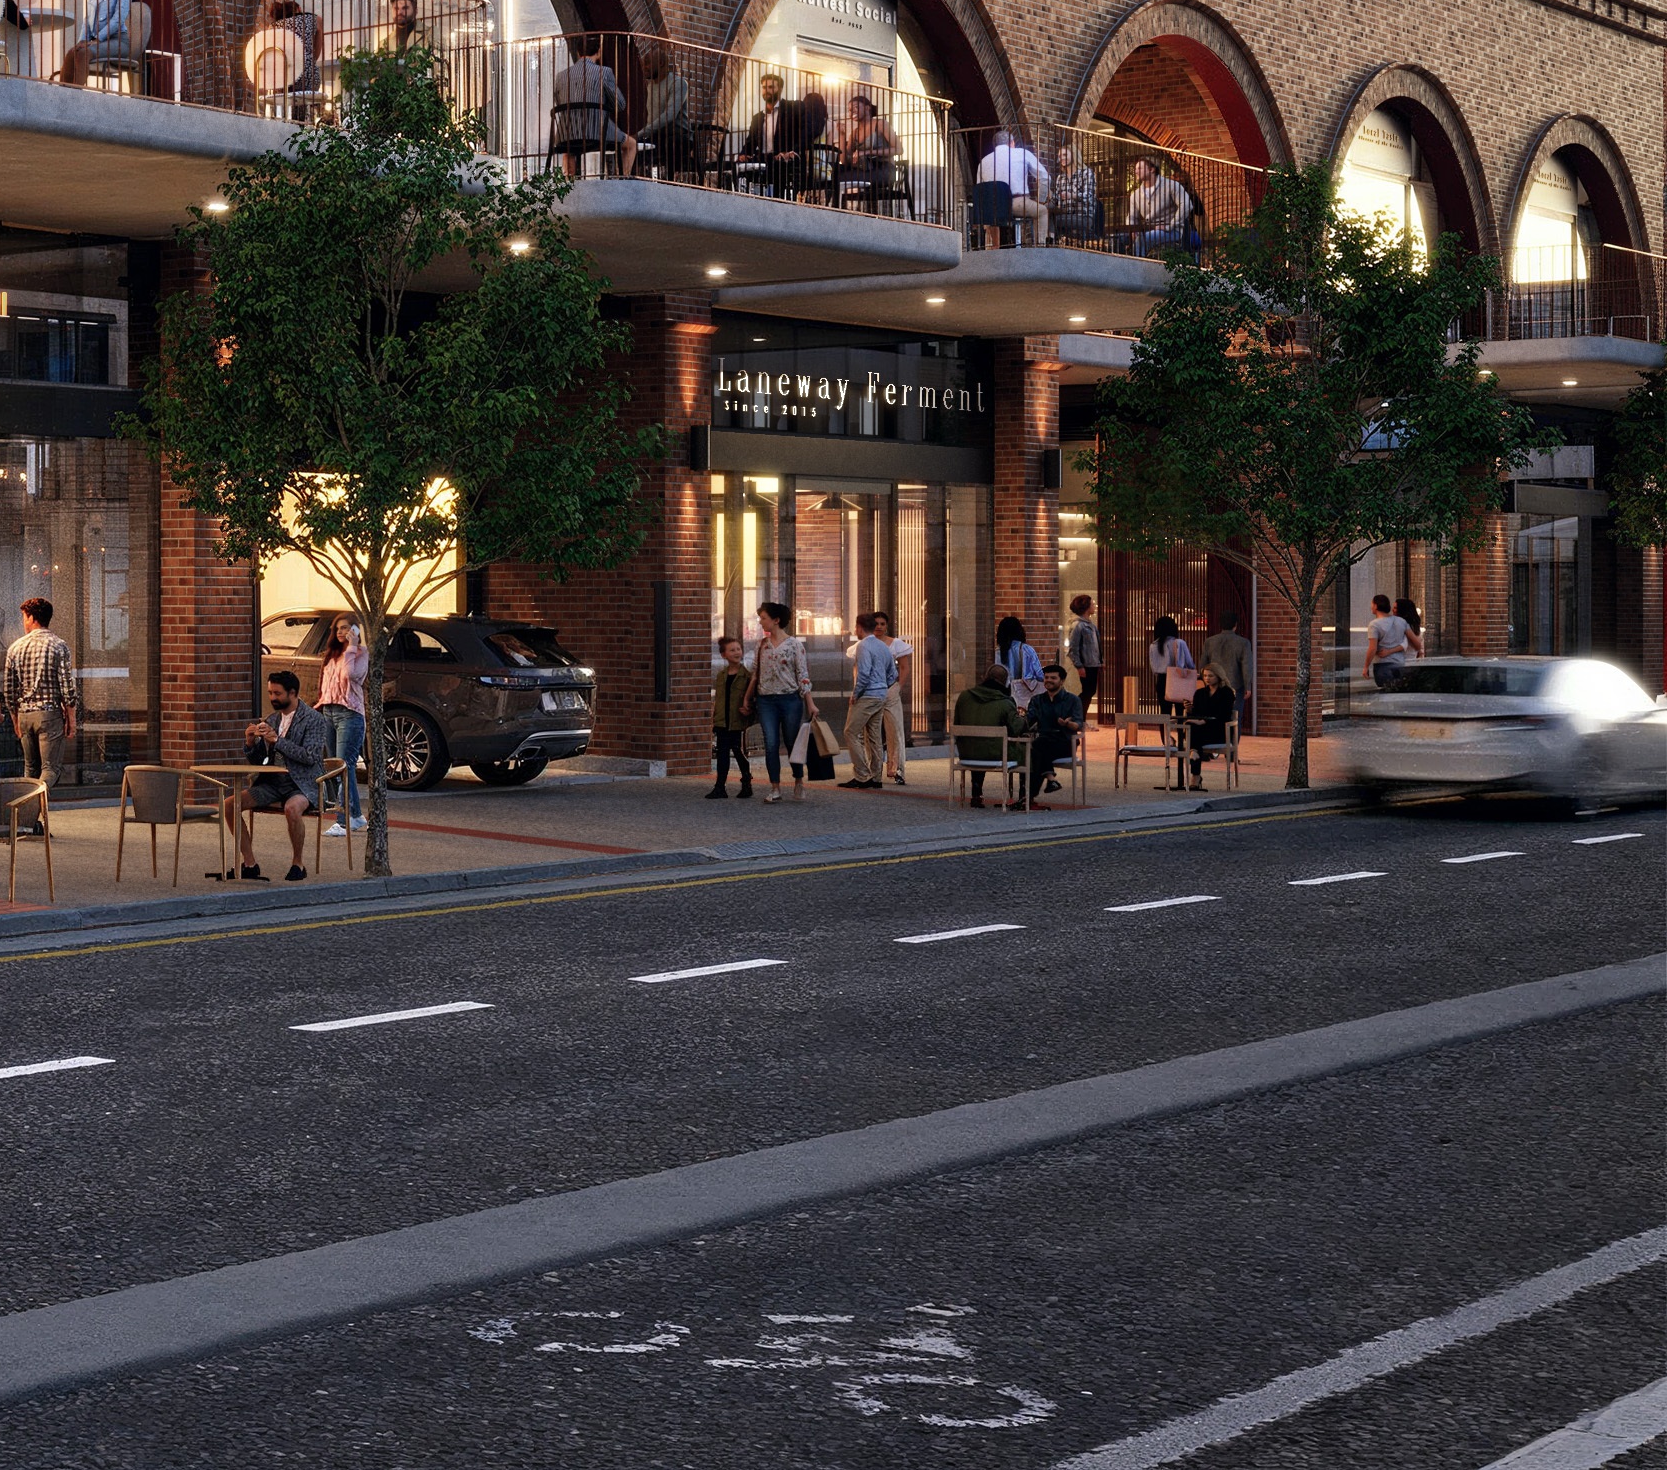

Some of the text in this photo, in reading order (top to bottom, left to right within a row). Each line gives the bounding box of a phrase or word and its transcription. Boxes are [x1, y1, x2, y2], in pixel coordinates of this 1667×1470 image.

[855, 1, 897, 25] Social
[718, 357, 985, 413] Laneway Ferment
[724, 400, 817, 418] Since 2015
